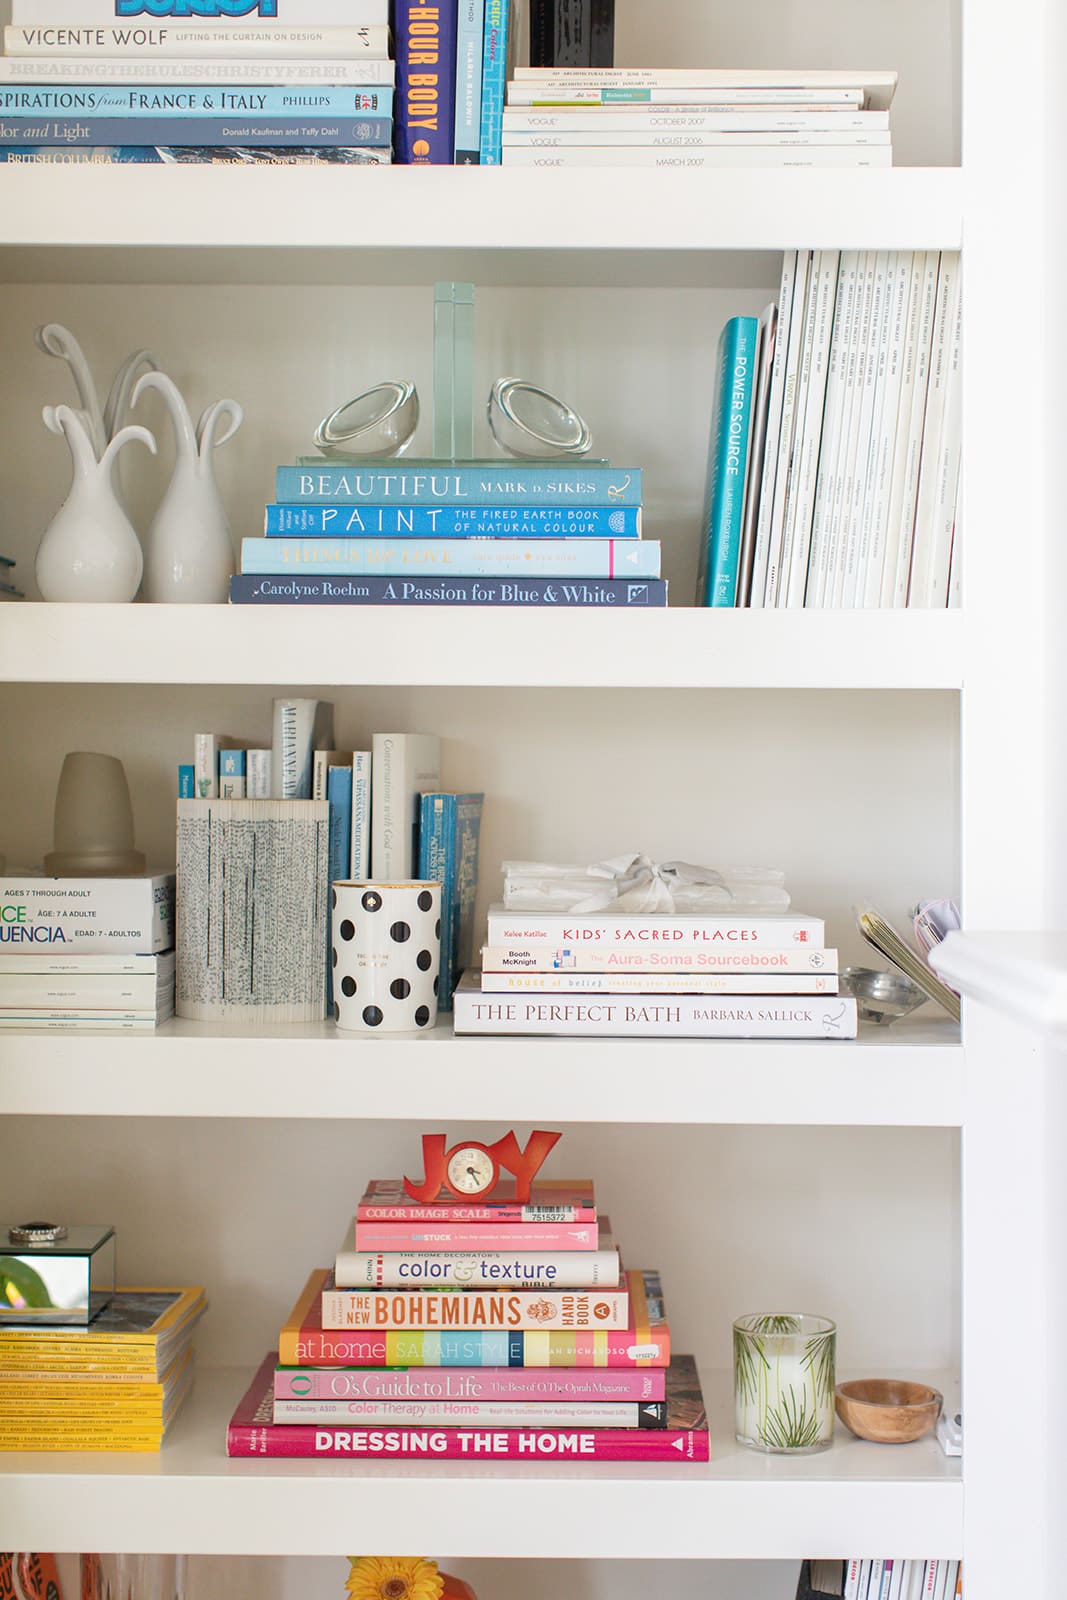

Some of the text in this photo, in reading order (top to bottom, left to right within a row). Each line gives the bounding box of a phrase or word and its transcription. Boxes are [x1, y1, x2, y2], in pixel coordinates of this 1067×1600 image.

[23, 29, 168, 46] VICENTE WOLF
[176, 33, 322, 41] LIFTING THE CURTAIN ON DESIGN
[488, 29, 499, 61] Colors
[464, 41, 475, 126] HILARIA BALDWIN
[129, 92, 197, 109] FRANCE
[203, 95, 214, 110] &
[221, 93, 268, 110] ITALY
[282, 97, 331, 106] PHILLIPS
[408, 74, 439, 131] BODY
[528, 118, 559, 126] VOGUE
[650, 117, 705, 126] OCTOBER 2007
[23, 124, 49, 138] and
[53, 124, 90, 141] Light
[223, 128, 249, 136] Donald
[251, 128, 283, 136] Kaufman
[286, 128, 299, 136] and
[321, 128, 339, 136] Dahl
[531, 138, 561, 146] VOGUE
[653, 137, 704, 145] AUGUST 2006
[534, 159, 565, 167] VOGUE
[656, 158, 704, 167] MARCH 2007
[726, 337, 748, 476] THE POWER SOURCE
[300, 475, 597, 496] BEAUTIFUL MARK SIKES
[724, 488, 734, 518] LAUREN
[322, 509, 443, 532] PAINT
[454, 510, 600, 520] THE FIRED EARTH BOOK
[454, 523, 595, 533] OF NATURAL COLOUR
[282, 548, 360, 563] THINGS
[402, 549, 454, 564] LOVE
[260, 581, 616, 603] Carolyne Roehm A Passion for Blue & White
[283, 706, 298, 777] MARIANNE
[383, 740, 394, 849] Conversations with God
[354, 755, 364, 871] Hart VIPASSANA MEDITATION
[68, 890, 91, 898] ADULT
[0, 906, 27, 923] CE
[108, 930, 142, 938] ADULTOS
[504, 930, 523, 938] Kelee
[563, 929, 606, 941] KIDS'
[615, 930, 684, 941] SACRED
[693, 930, 759, 942] PLACES
[502, 959, 537, 967] McKnight
[607, 953, 789, 967] Aura-Soma Sourcebook
[508, 977, 603, 989] house of belief
[472, 1004, 813, 1023] THE PERFECT BATH BARBARA SALLICK
[403, 1129, 563, 1204] JOY
[366, 1208, 406, 1219] COLOR
[410, 1208, 449, 1219] IMAGE
[452, 1208, 491, 1219] SCALE
[532, 1213, 566, 1222] 7515372
[399, 1259, 557, 1281] color & texture
[350, 1297, 371, 1309] THE
[374, 1296, 522, 1325] BOHEMIANS
[561, 1296, 574, 1326] HAND
[577, 1296, 589, 1326] BOOK
[346, 1312, 371, 1324] NEW
[294, 1335, 521, 1359] at home SARAH STYLE
[331, 1375, 483, 1397] O's Guide to Life
[490, 1382, 630, 1395] The Best of The Oprah Magazine
[348, 1402, 479, 1417] Color Therapy at Home
[554, 1408, 575, 1416] Adding
[576, 1408, 592, 1416] Color
[315, 1432, 595, 1453] DRESSING THE HOME
